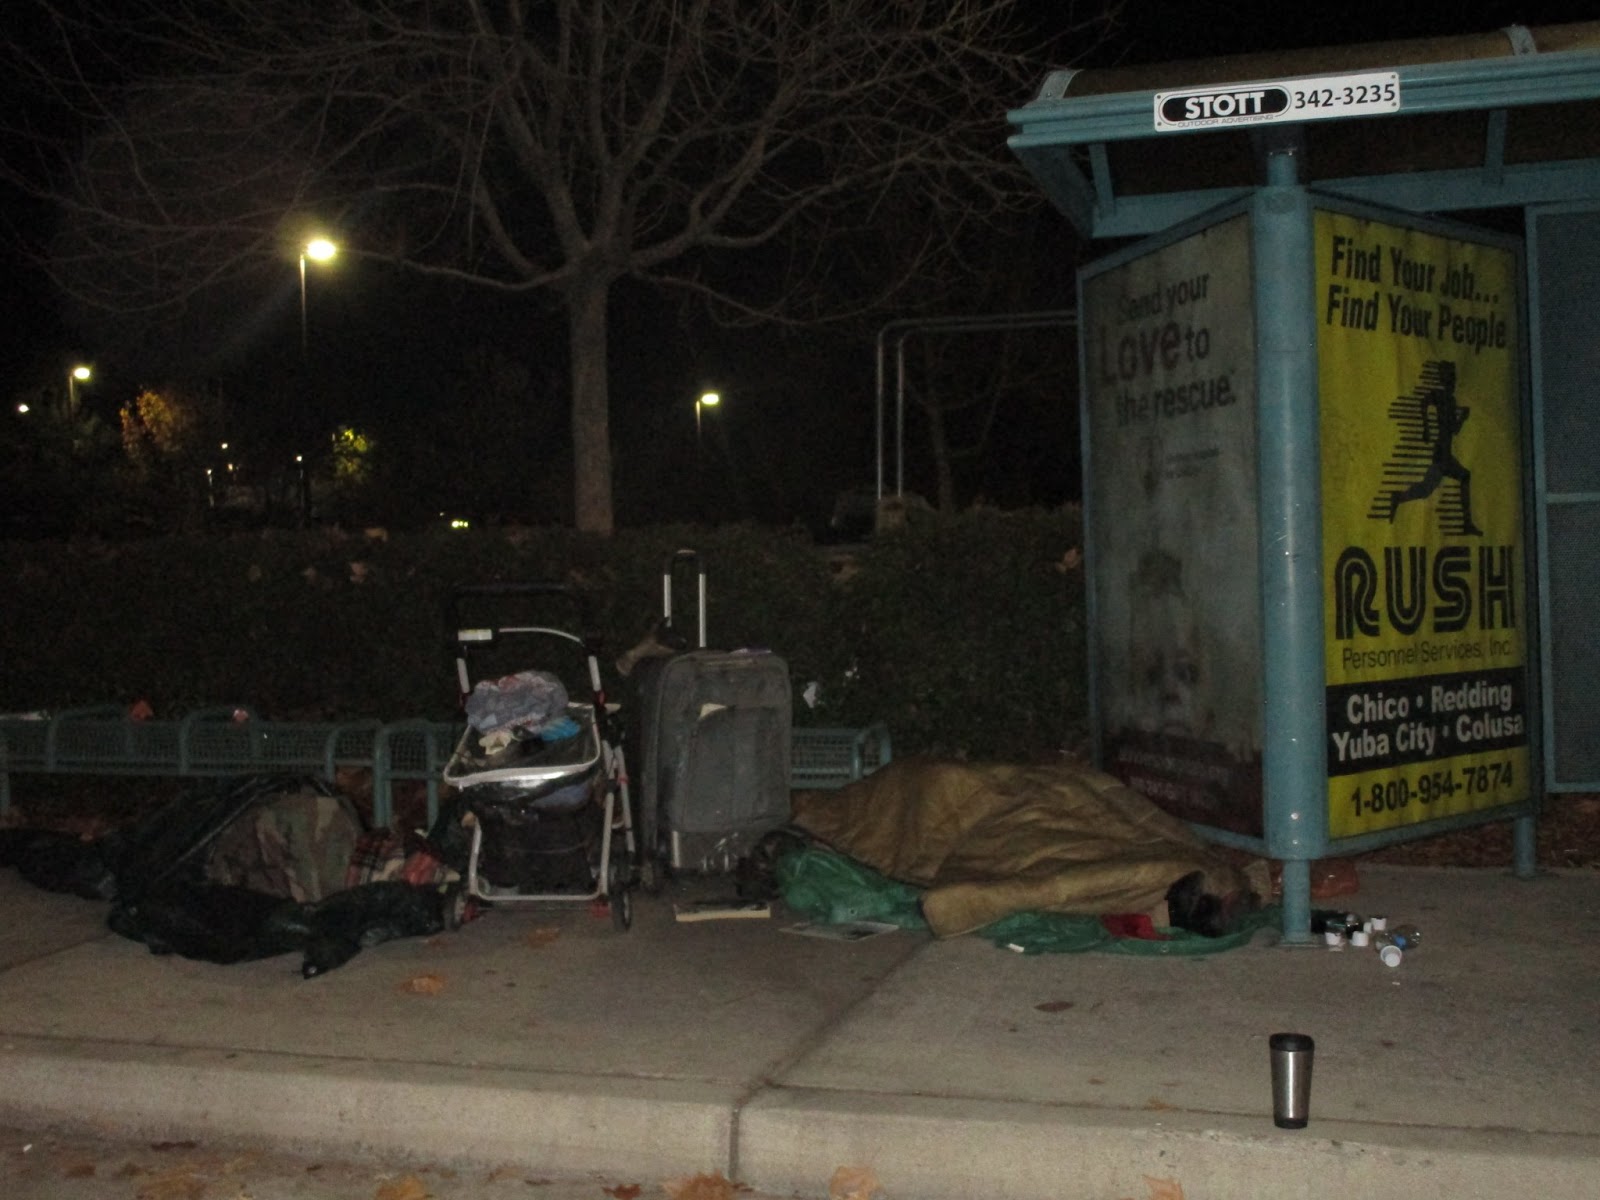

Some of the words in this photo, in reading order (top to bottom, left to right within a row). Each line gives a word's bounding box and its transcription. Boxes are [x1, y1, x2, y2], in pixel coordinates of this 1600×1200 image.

[1184, 91, 1265, 119] STOTT
[1294, 83, 1396, 110] 342-3235
[1177, 118, 1219, 128] OUTDOOR
[1331, 235, 1381, 283] Find
[1390, 246, 1436, 293] Your
[1166, 273, 1210, 317] your
[1327, 284, 1380, 332] Find
[1388, 292, 1433, 339] Your
[1437, 303, 1507, 355] People
[1099, 320, 1182, 385] Love
[1185, 326, 1211, 363] to
[1115, 388, 1150, 427] the
[1334, 546, 1515, 639] RUSH
[1342, 643, 1418, 671] Personnel
[1347, 692, 1410, 725] Chico
[1431, 681, 1512, 712] Redding
[1332, 728, 1390, 762] Yuba
[1396, 721, 1436, 756] City
[1456, 712, 1525, 743] Colusa
[1350, 760, 1515, 817] 1-800-954-7874
